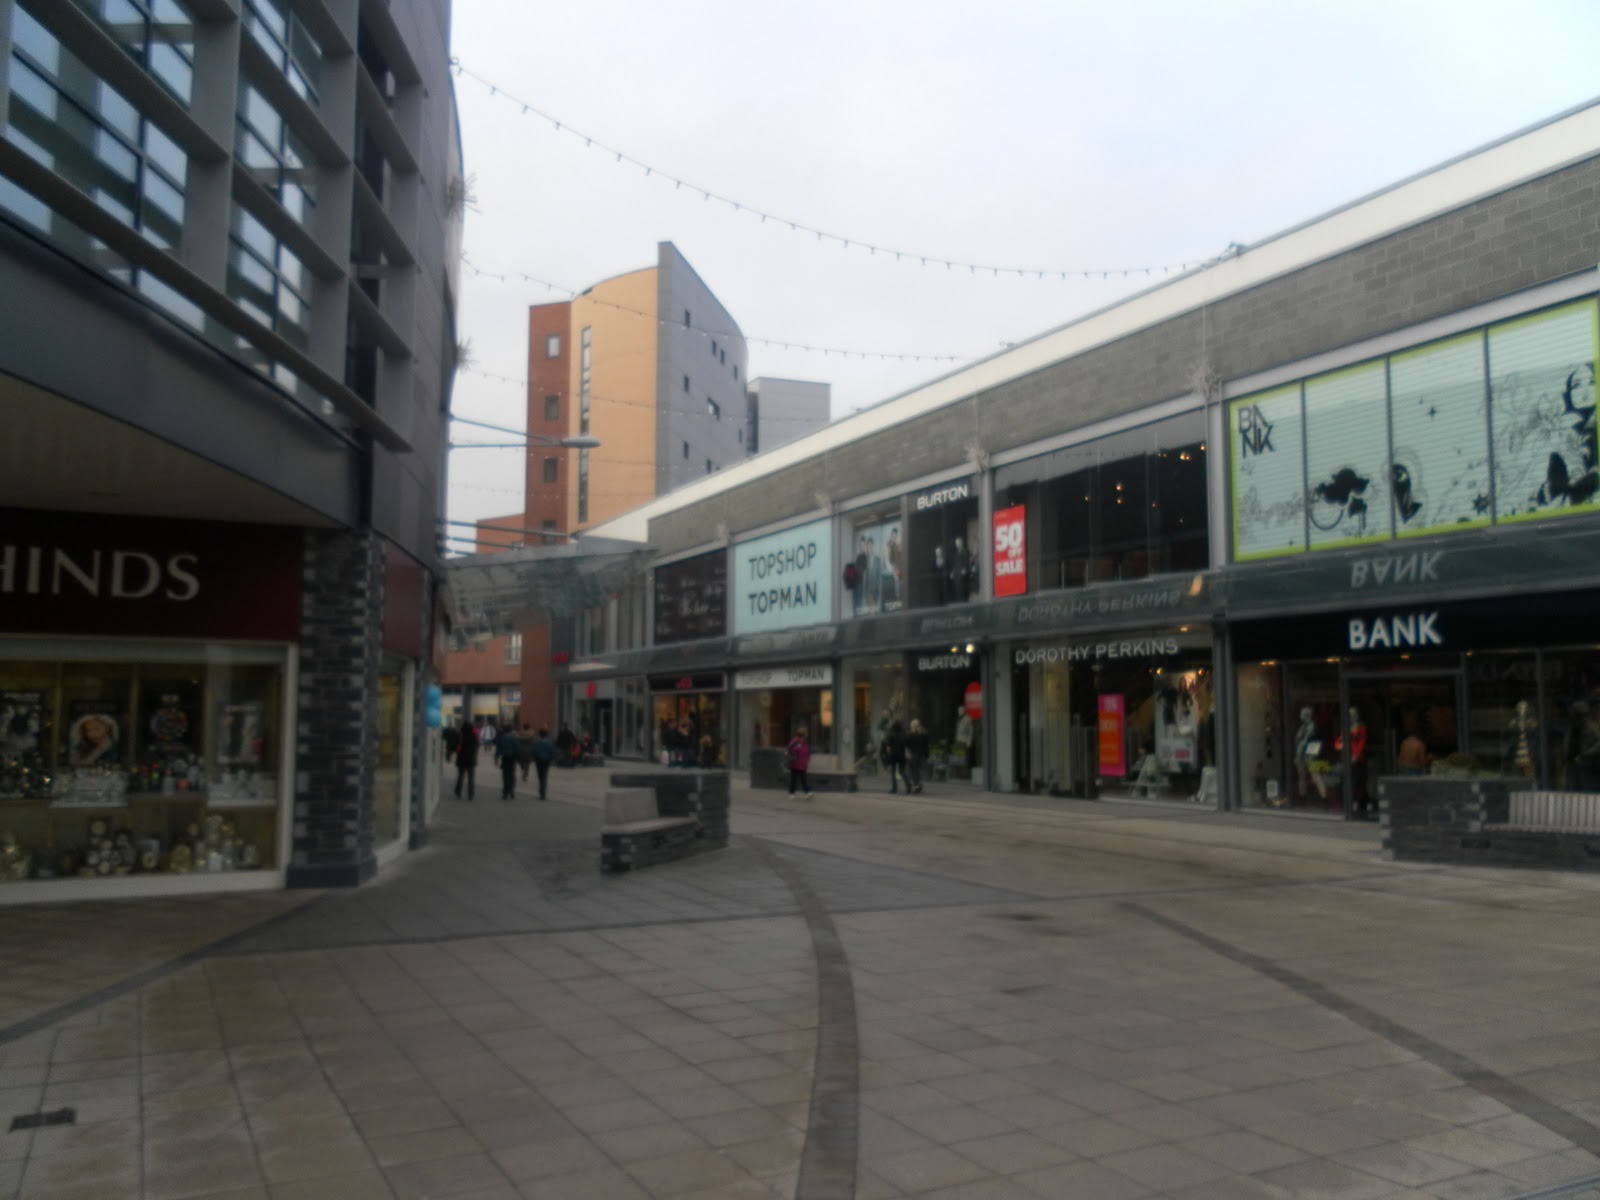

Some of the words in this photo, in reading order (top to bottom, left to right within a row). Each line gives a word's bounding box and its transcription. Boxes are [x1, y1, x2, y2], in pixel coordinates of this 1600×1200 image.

[917, 484, 968, 510] BURTON
[749, 542, 816, 580] TOPSHOP
[996, 559, 1024, 577] SALE
[749, 582, 817, 615] TOPMAN
[1349, 611, 1442, 650] BANK
[918, 654, 970, 671] BURTON
[1015, 645, 1092, 664] DOROTHY
[1096, 638, 1179, 659] PERKINS
[787, 667, 825, 682] TOPMAN
